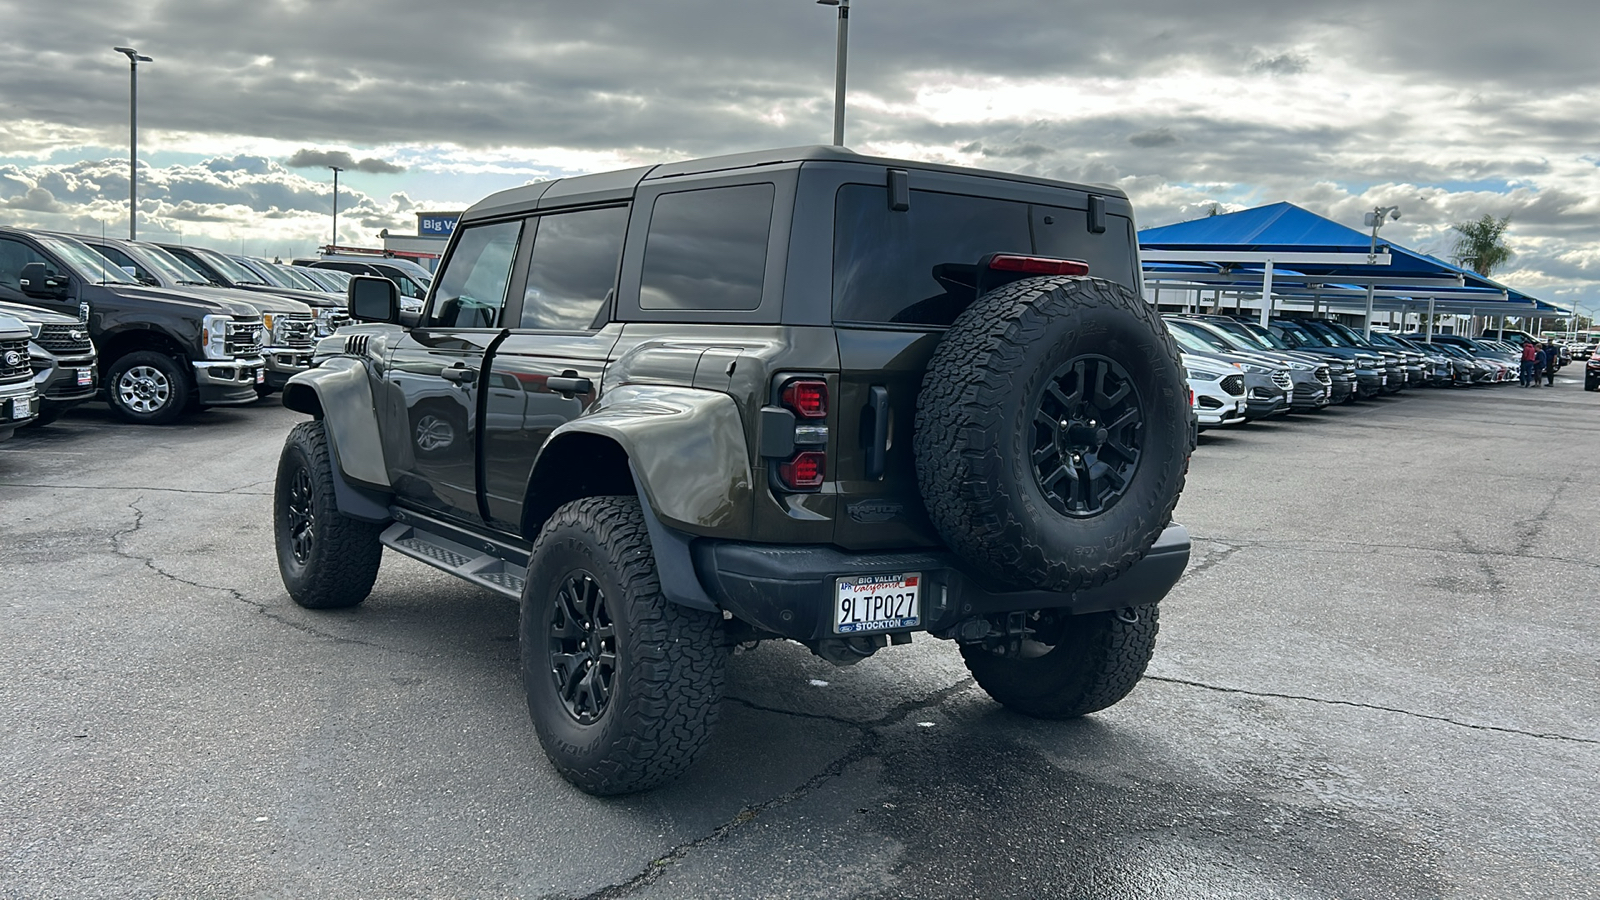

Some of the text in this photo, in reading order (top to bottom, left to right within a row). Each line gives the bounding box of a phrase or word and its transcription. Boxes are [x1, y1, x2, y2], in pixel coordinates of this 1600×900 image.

[423, 219, 442, 231] Big
[846, 504, 903, 516] RAPTOR
[874, 575, 902, 583] VALLEY
[841, 593, 915, 623] 9LTP027
[856, 620, 901, 631] STOCKTON
